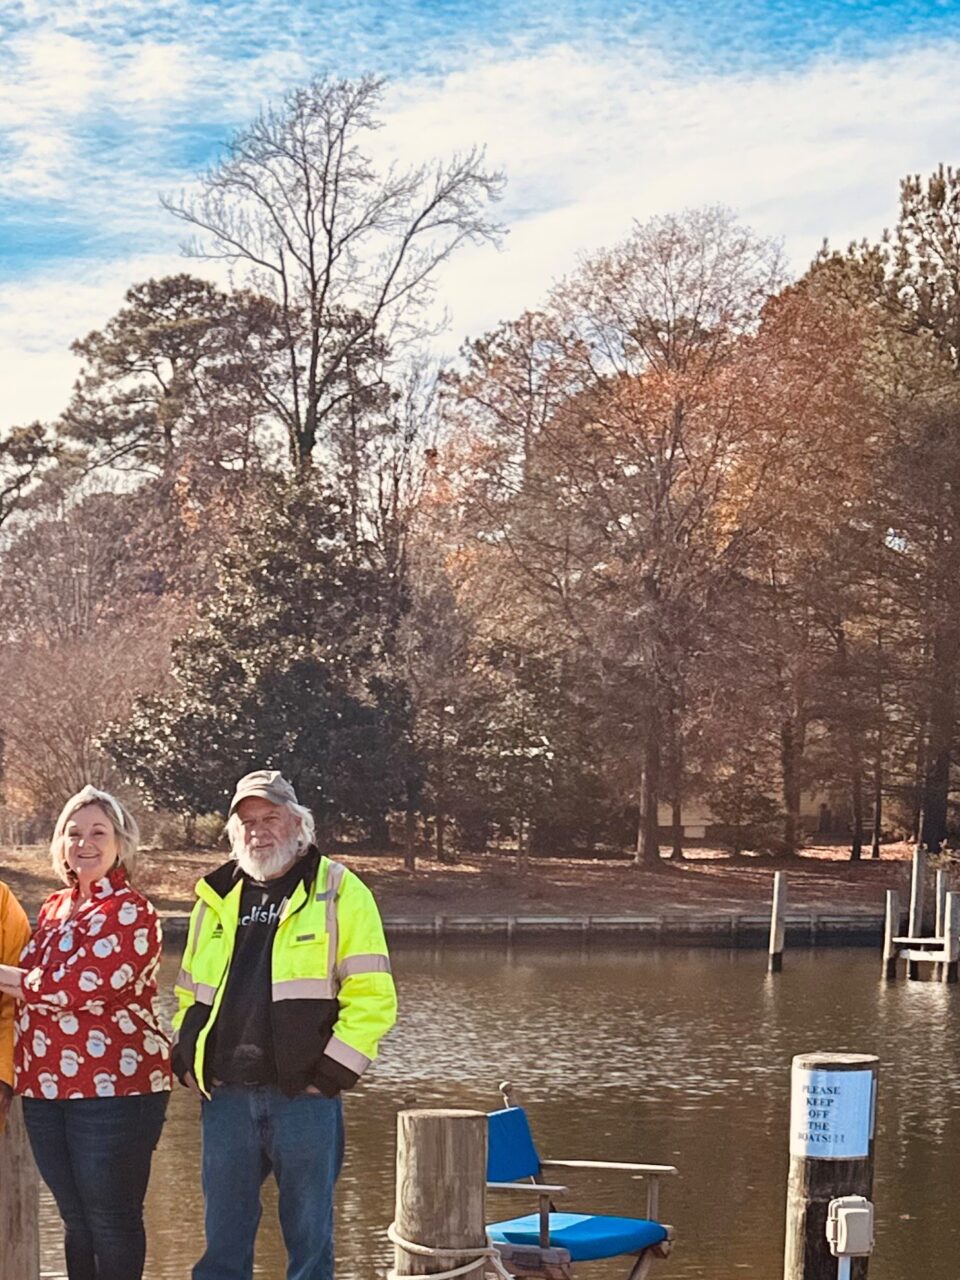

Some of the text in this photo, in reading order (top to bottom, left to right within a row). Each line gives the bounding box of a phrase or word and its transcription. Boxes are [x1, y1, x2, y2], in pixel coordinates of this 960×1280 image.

[802, 1085, 840, 1095] PLEASE
[806, 1098, 834, 1107] KEEP
[808, 1110, 830, 1119] OFF
[807, 1122, 830, 1131] THE
